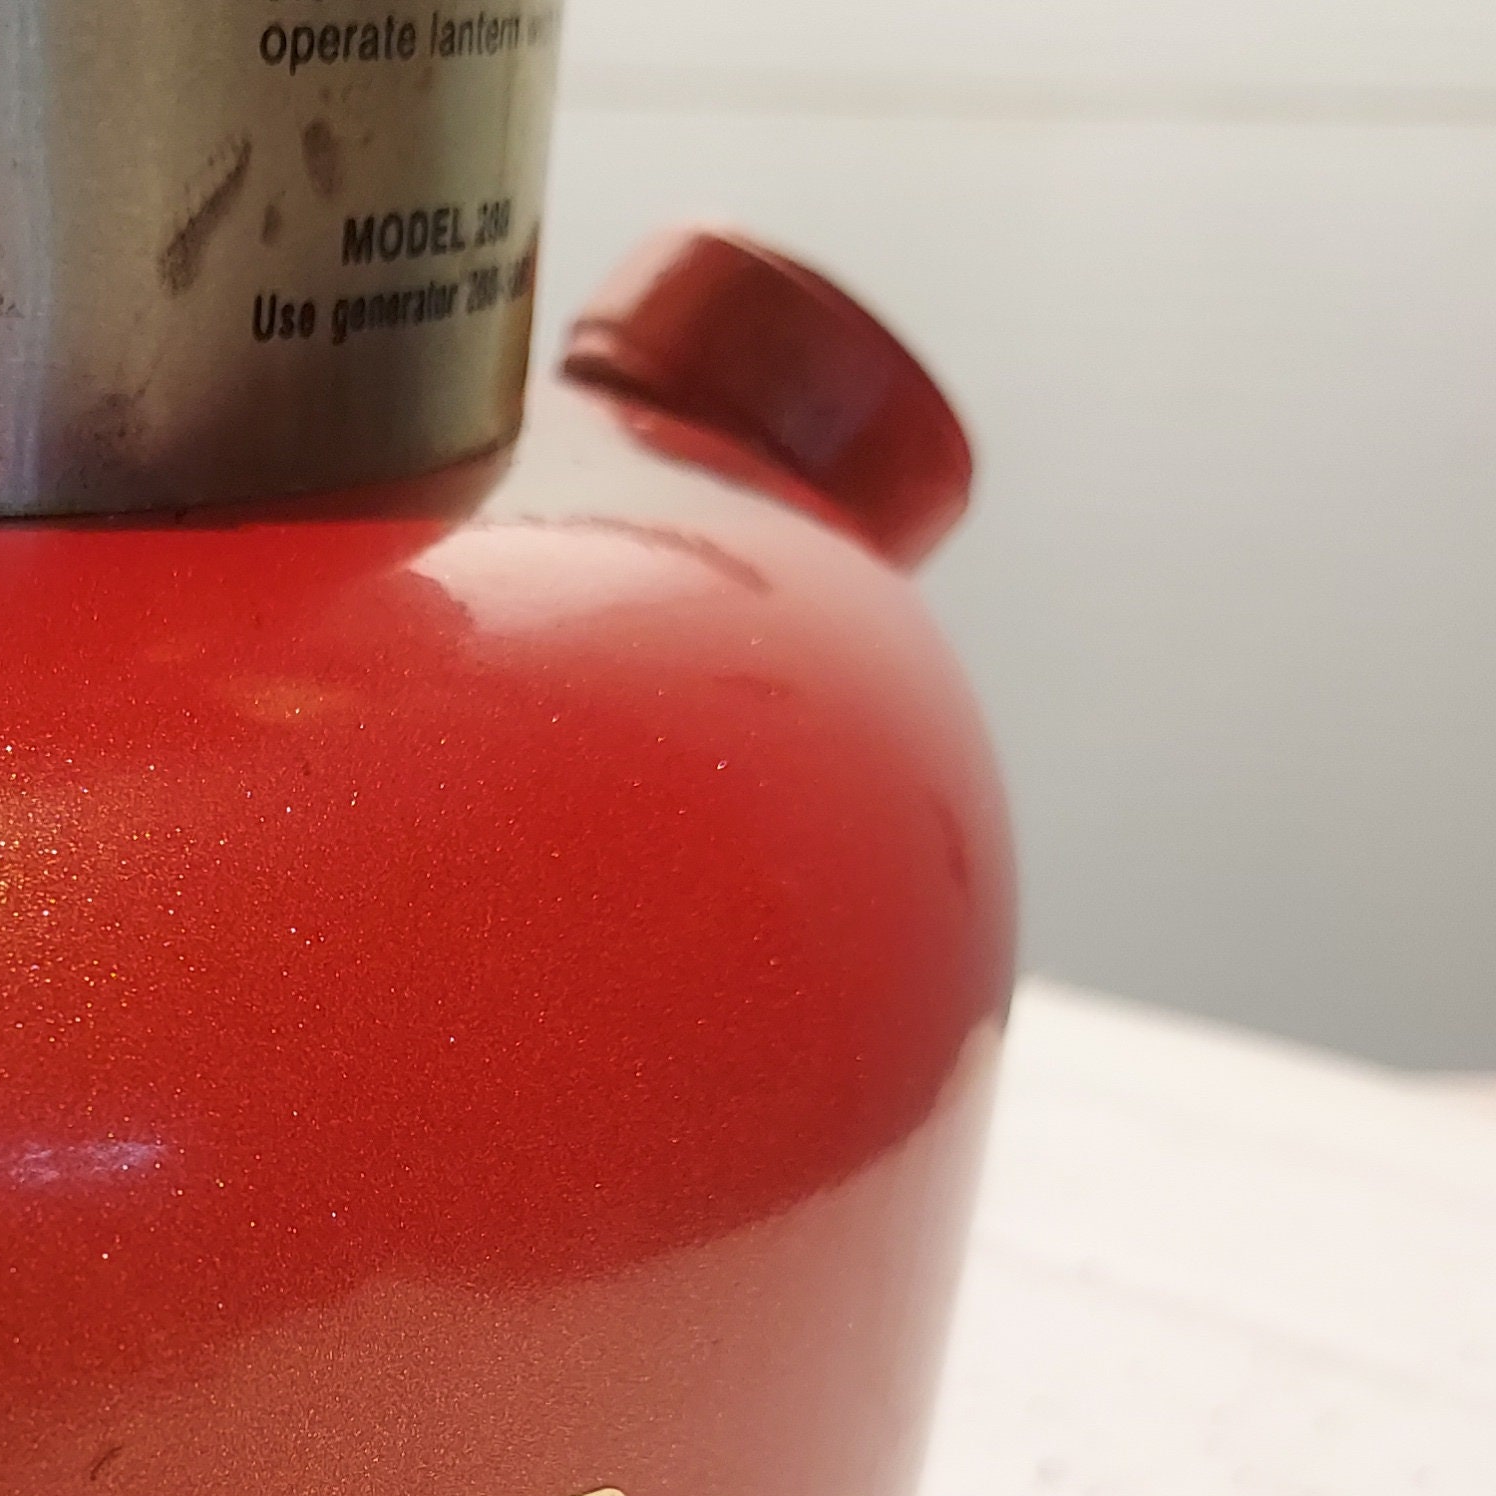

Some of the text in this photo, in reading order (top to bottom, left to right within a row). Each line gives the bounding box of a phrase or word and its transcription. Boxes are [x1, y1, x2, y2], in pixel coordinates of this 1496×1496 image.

[259, 14, 416, 76] operate
[430, 10, 520, 58] lantern
[341, 206, 467, 266] MODEL
[252, 292, 317, 343] Use
